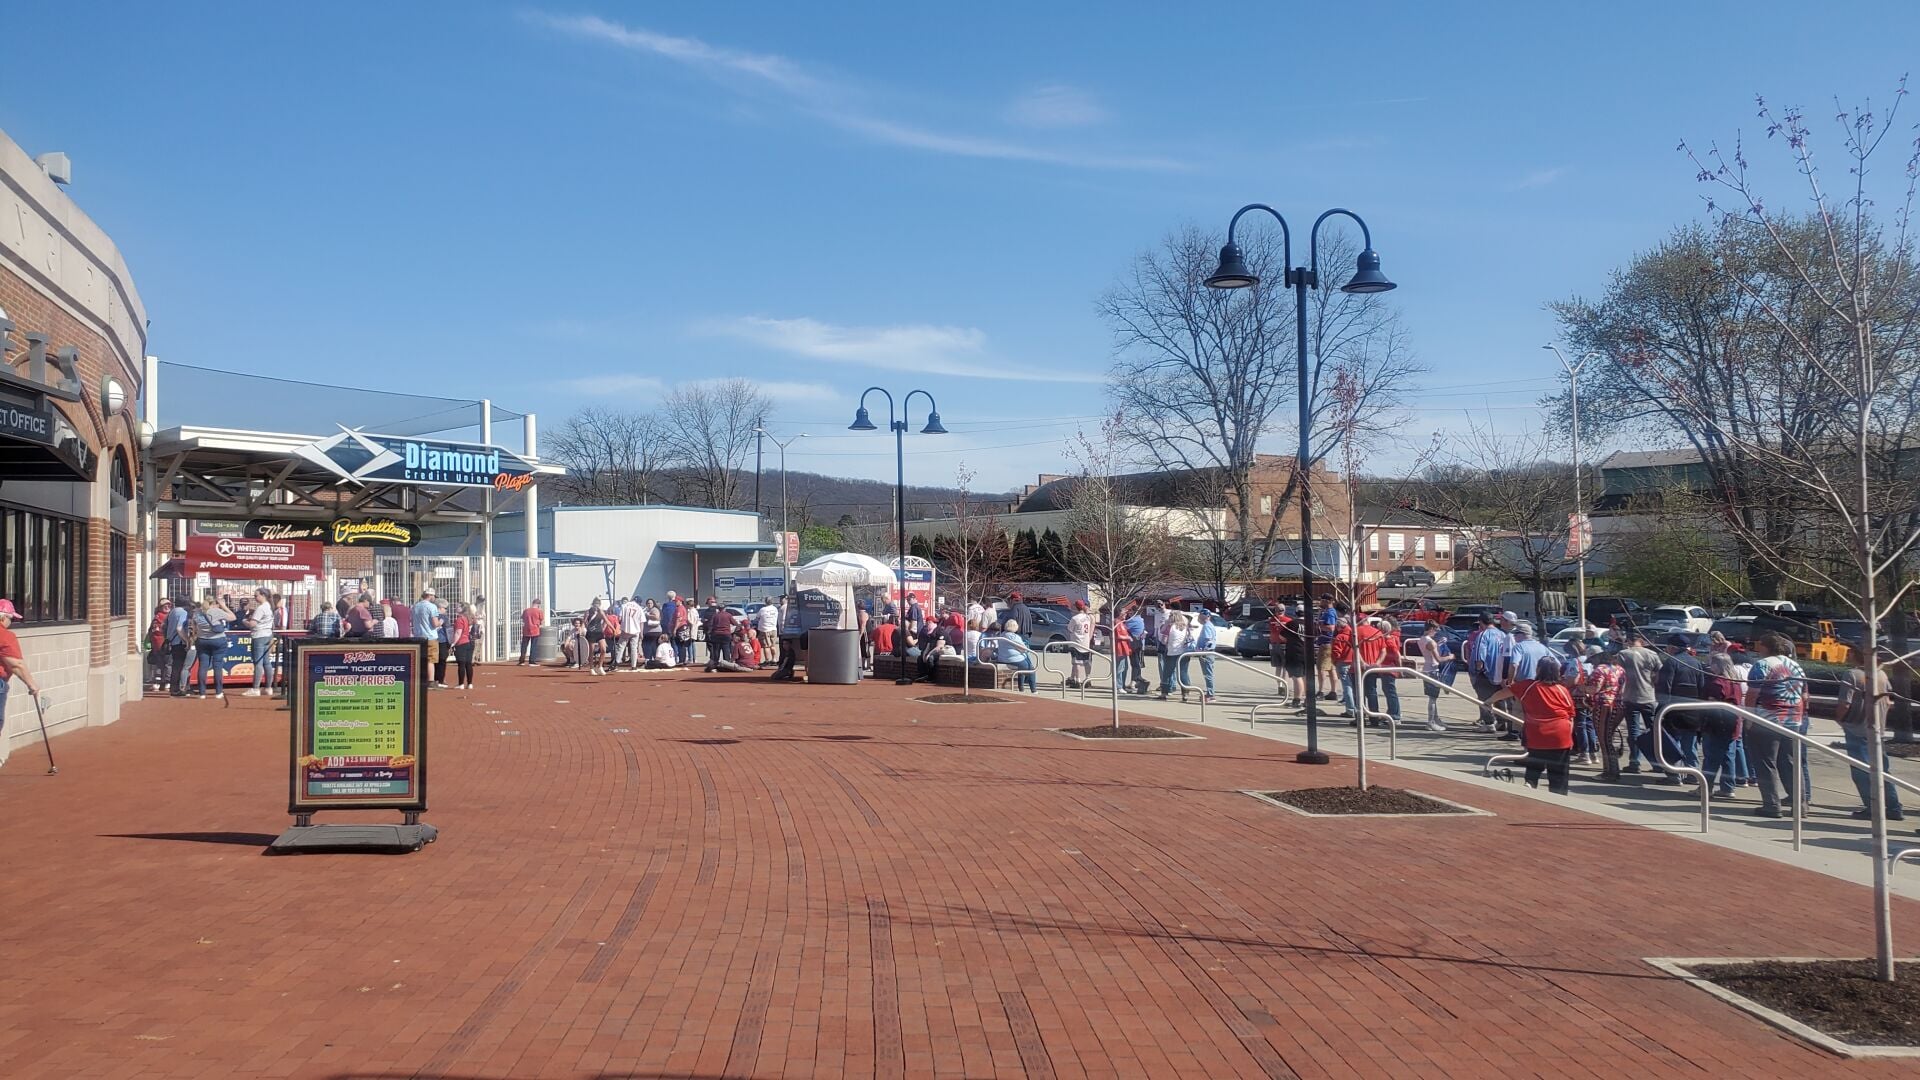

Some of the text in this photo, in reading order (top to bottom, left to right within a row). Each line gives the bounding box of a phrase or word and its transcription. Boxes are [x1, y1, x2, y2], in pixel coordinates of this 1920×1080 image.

[10, 409, 46, 435] OFFICE
[405, 442, 499, 474] Diamond
[404, 469, 489, 484] Credit Union
[494, 472, 533, 492] Plaza
[258, 523, 309, 540] Welcome
[312, 526, 325, 537] to
[256, 545, 270, 553] STAR
[271, 546, 289, 554] TOURS
[343, 652, 376, 663] R-Phils
[324, 675, 395, 686] TICKET PRICES
[327, 756, 345, 767] ADD
